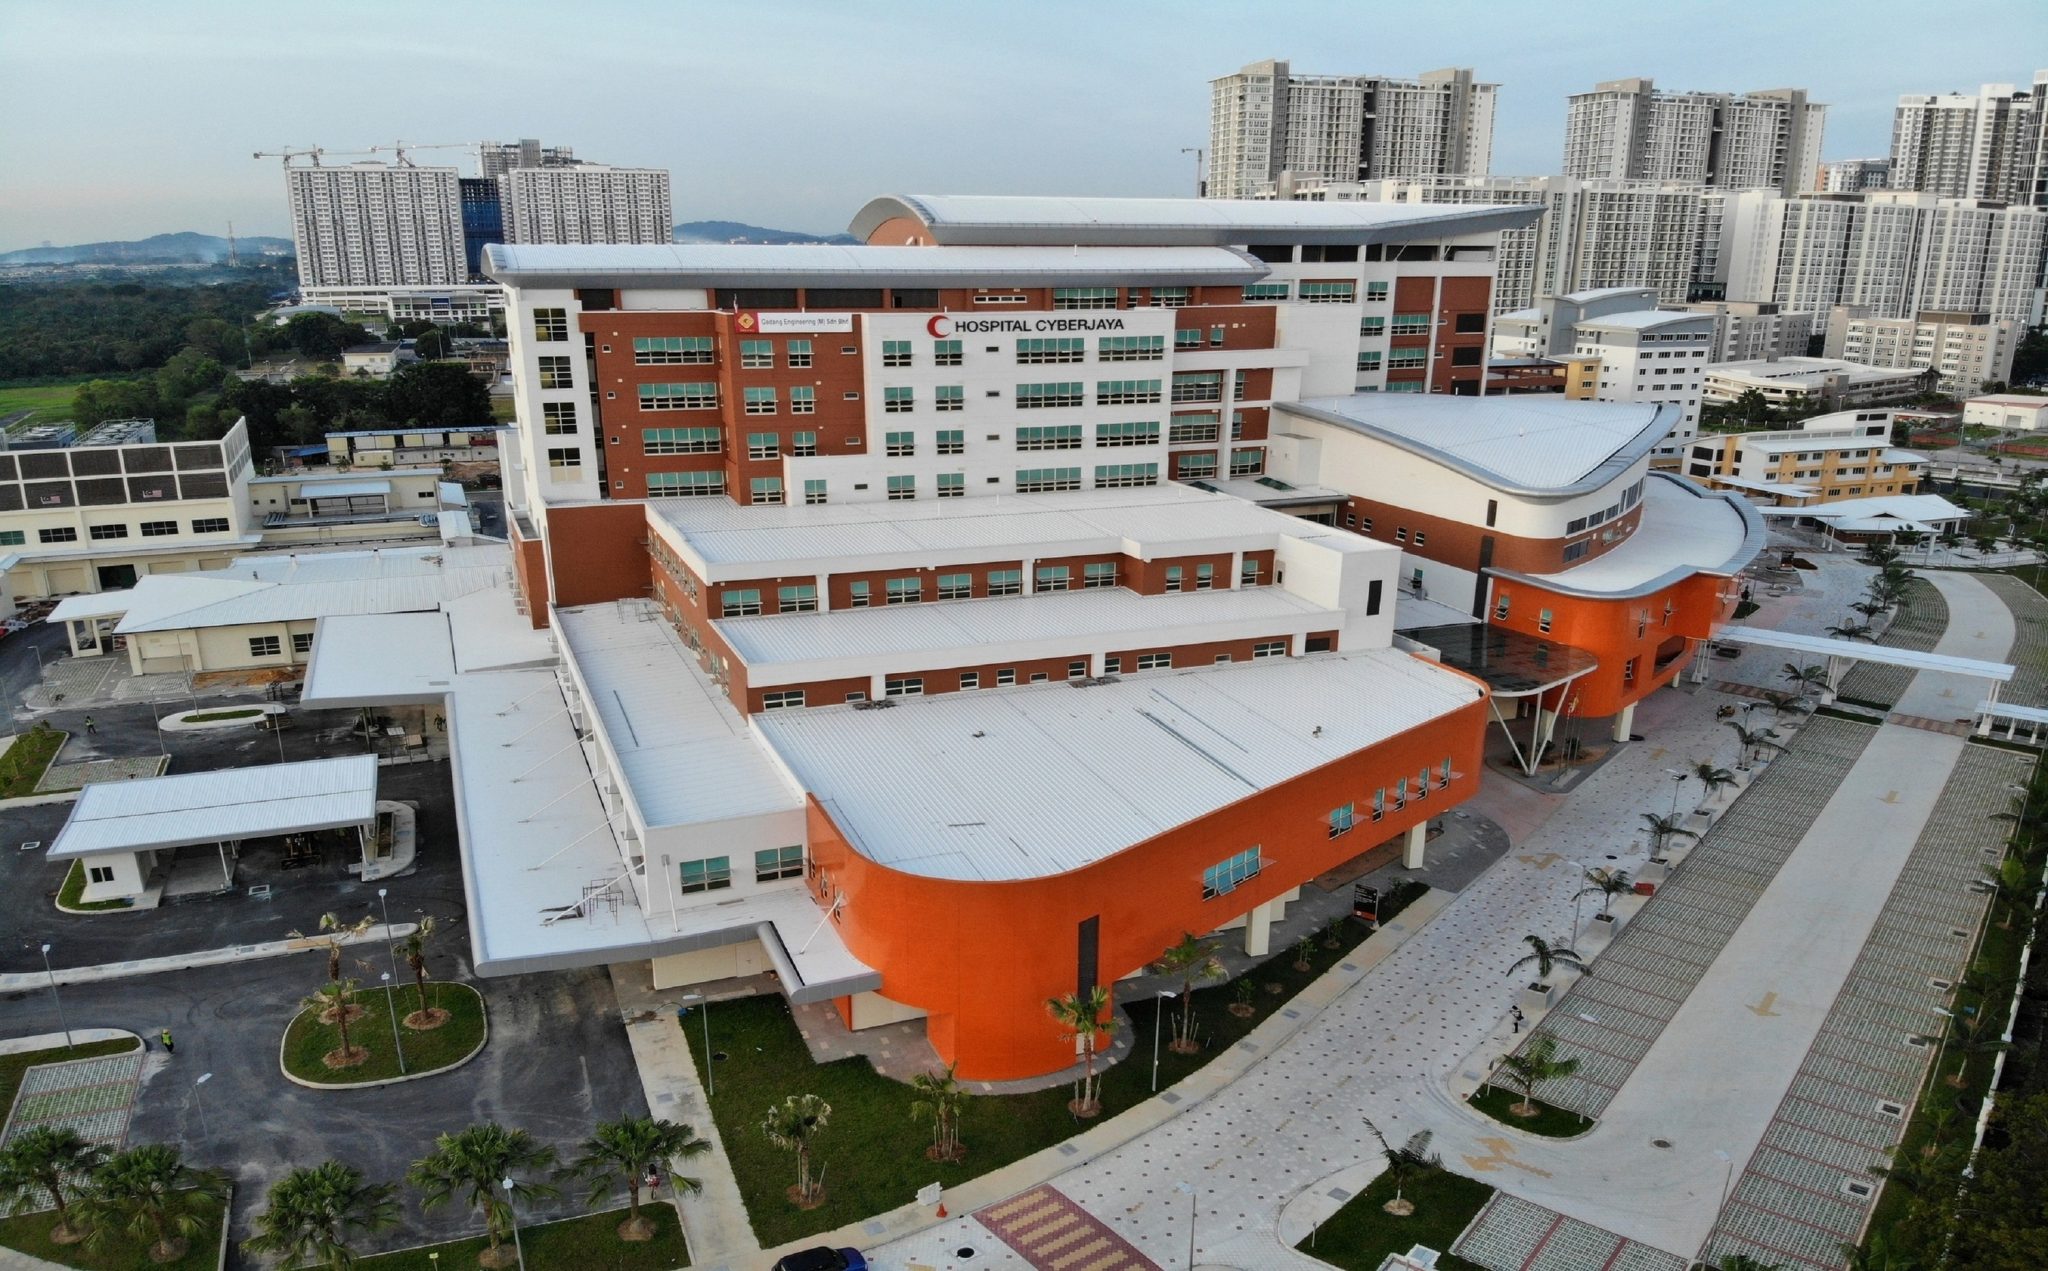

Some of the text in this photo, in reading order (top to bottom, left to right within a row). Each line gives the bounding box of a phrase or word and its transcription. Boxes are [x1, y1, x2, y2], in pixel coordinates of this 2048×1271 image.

[784, 318, 816, 326] Engineering
[955, 319, 1124, 332] HOSPITAL CYBERJAYA
